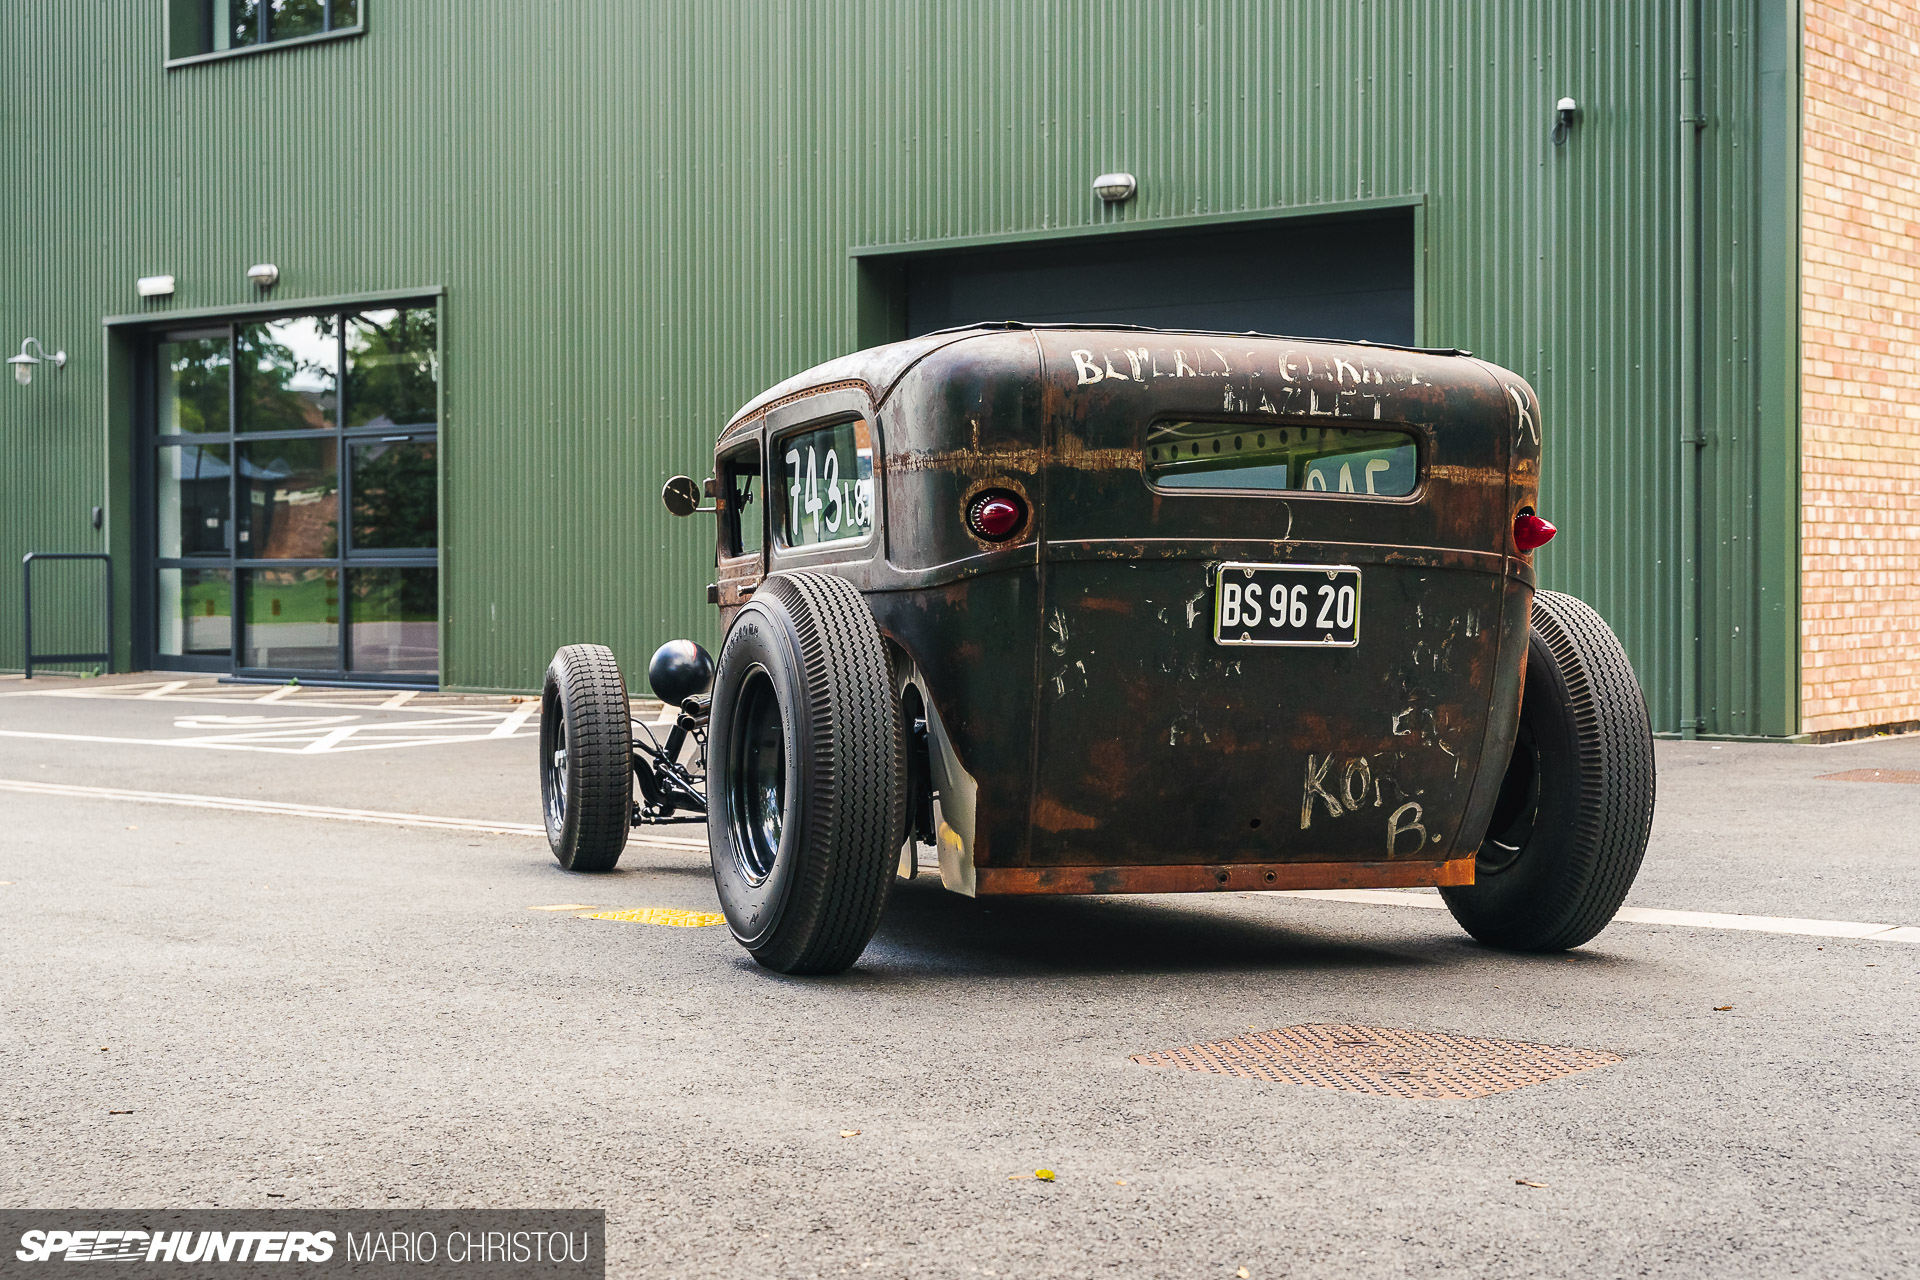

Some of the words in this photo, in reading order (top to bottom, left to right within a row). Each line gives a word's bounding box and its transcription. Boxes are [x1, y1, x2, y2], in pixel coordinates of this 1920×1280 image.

[786, 445, 842, 535] 743
[1222, 583, 1262, 627] BS
[1269, 584, 1308, 628] 96
[1316, 585, 1355, 629] 20
